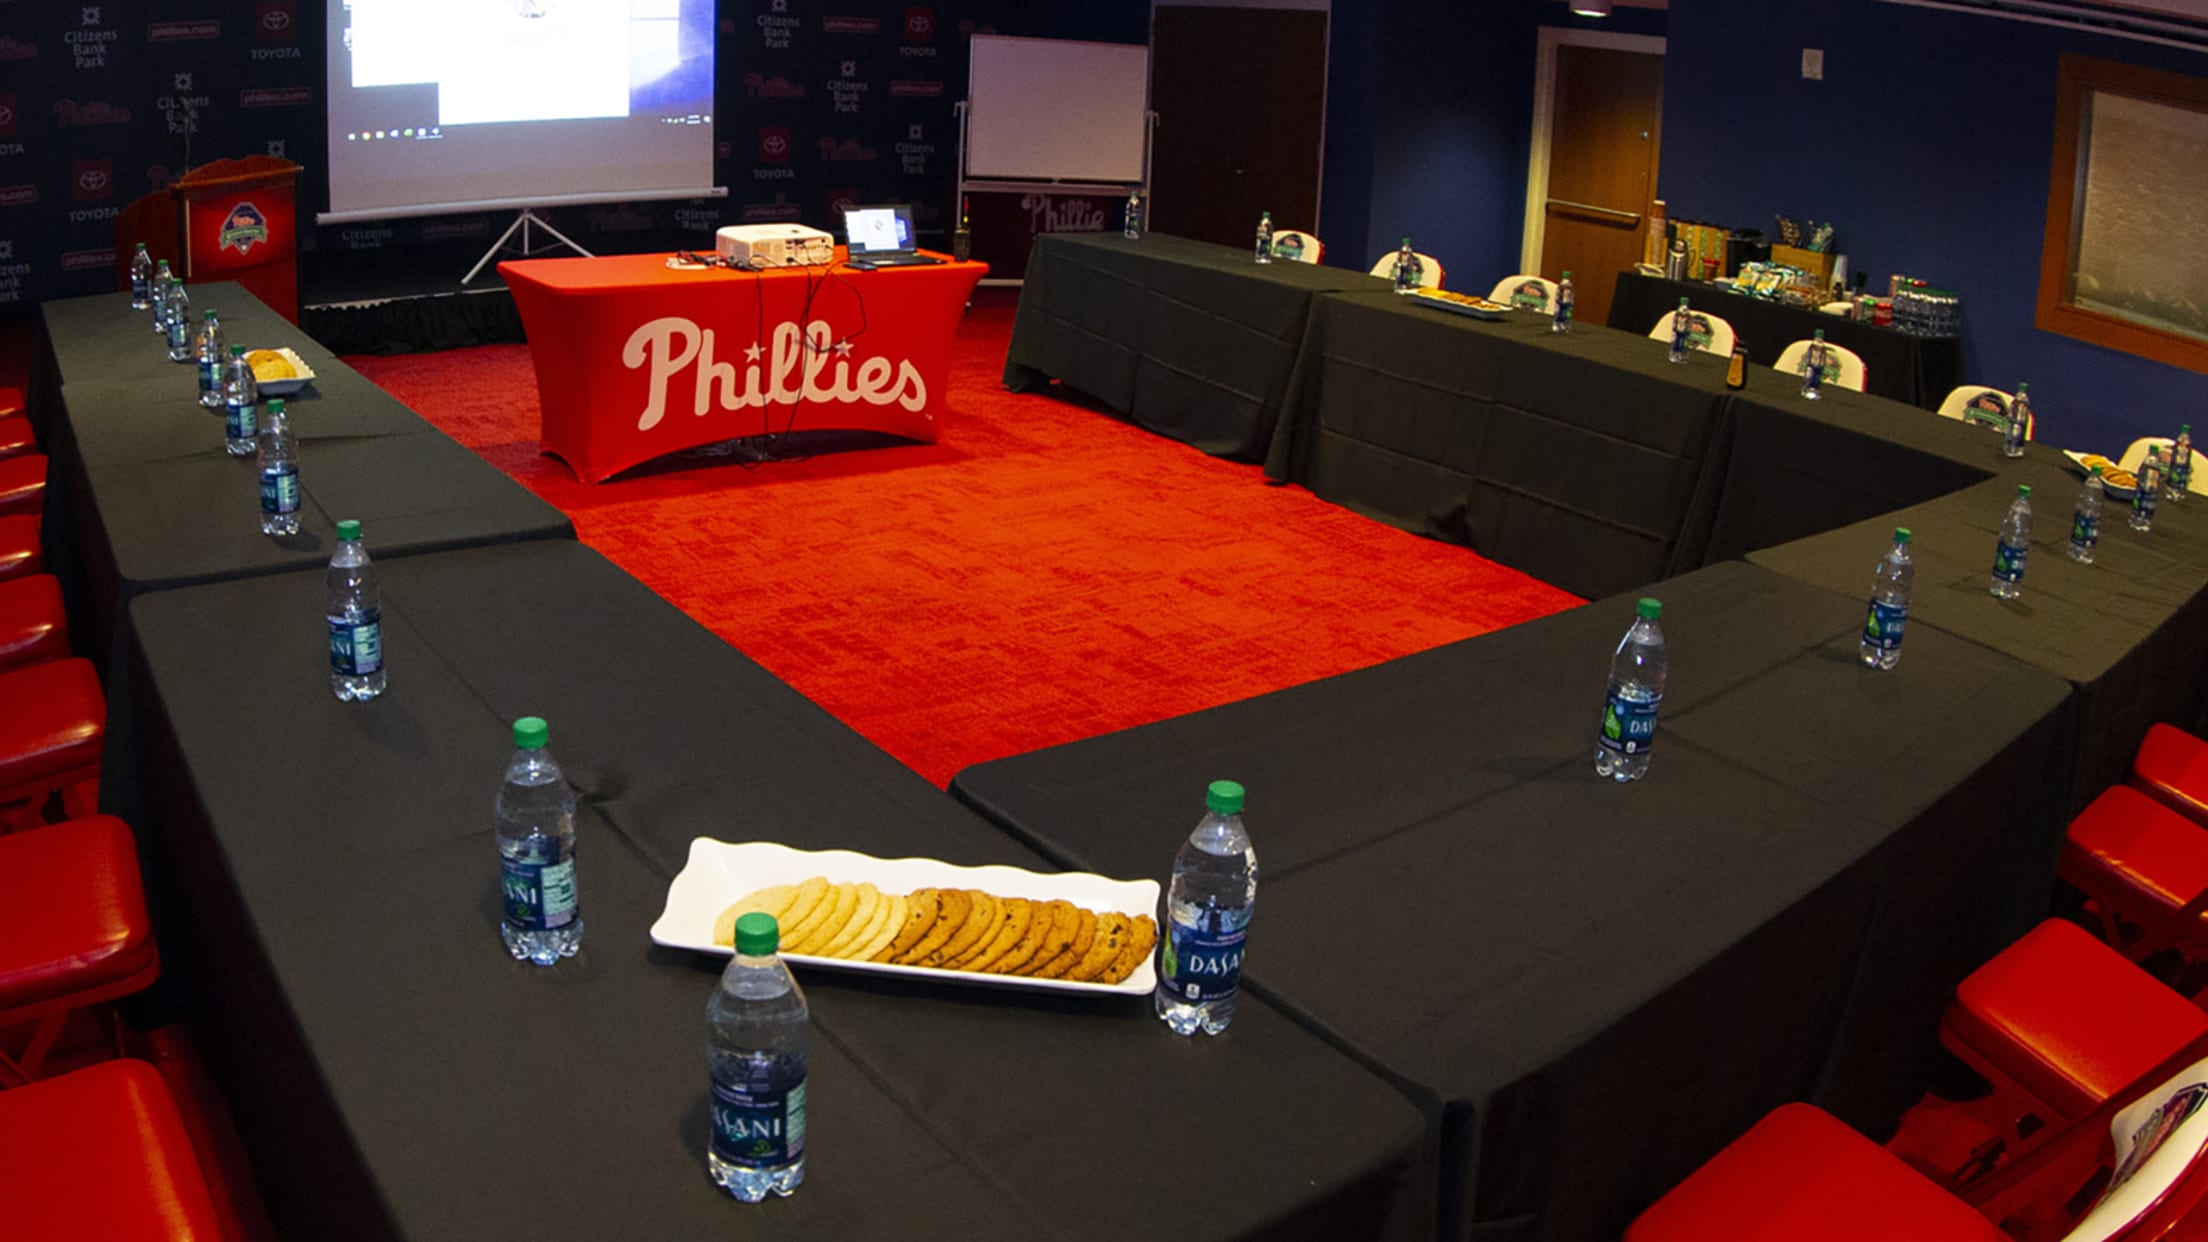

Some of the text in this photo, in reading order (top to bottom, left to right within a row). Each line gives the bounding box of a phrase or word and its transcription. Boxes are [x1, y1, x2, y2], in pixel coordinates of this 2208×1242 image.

[64, 29, 118, 44] Citizens
[73, 43, 107, 56] Bank
[251, 48, 301, 60] TOYOTA
[75, 55, 105, 69] Park
[753, 168, 796, 180] TOYOTA
[68, 207, 120, 222] TOYOTA
[621, 316, 927, 431] Phillies
